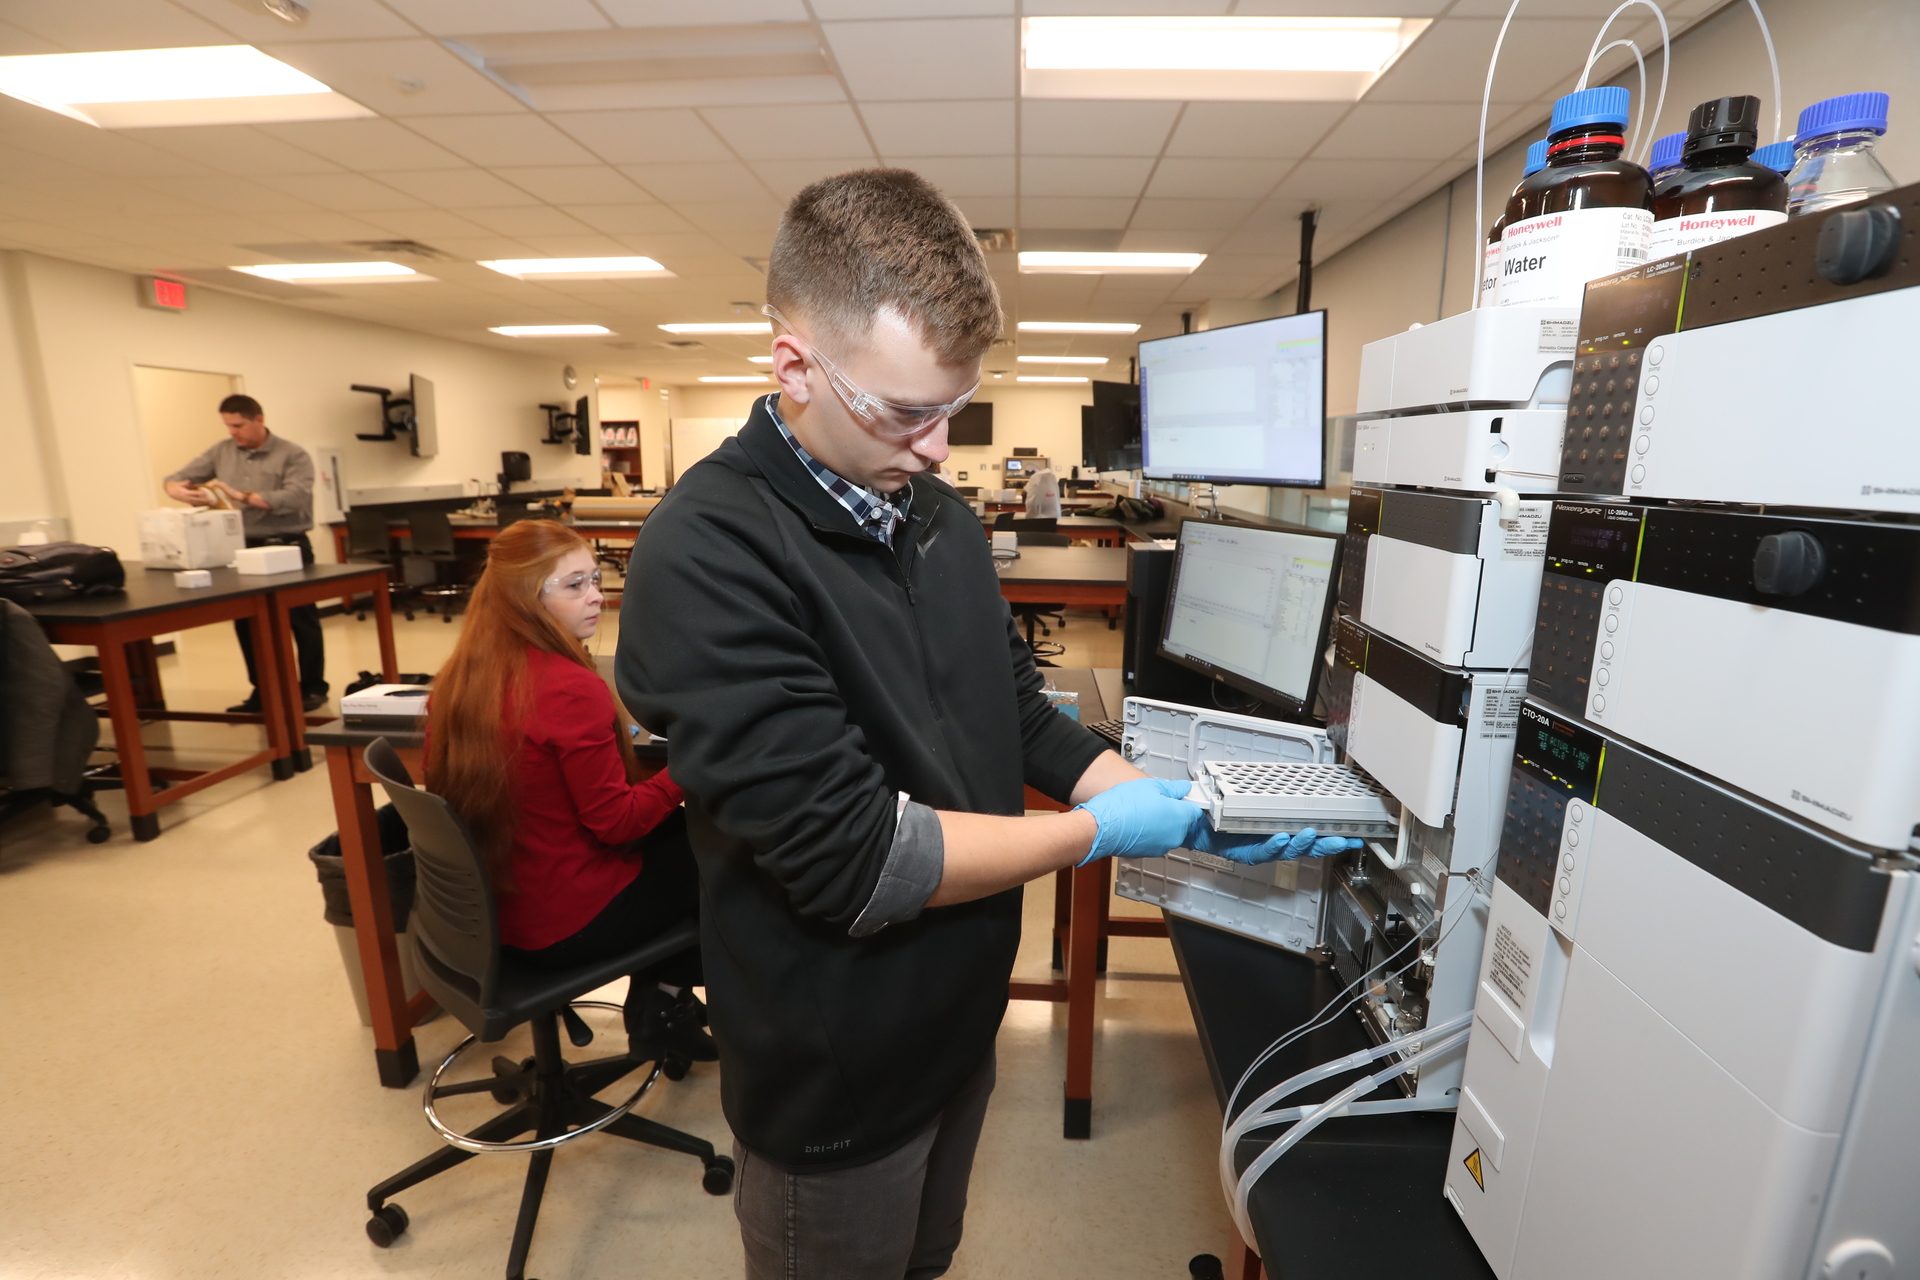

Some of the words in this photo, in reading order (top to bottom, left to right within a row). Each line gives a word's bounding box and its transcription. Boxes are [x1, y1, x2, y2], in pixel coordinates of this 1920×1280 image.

[1507, 216, 1562, 238] Honeywell
[1680, 215, 1755, 231] Honeywell
[1676, 237, 1706, 246] Burdick
[1504, 256, 1546, 276] Water
[1555, 504, 1582, 512] Nexera
[1607, 508, 1628, 516] LC-20AD
[1522, 707, 1550, 727] CTO-20A
[805, 1139, 851, 1153] DRI-FIT
